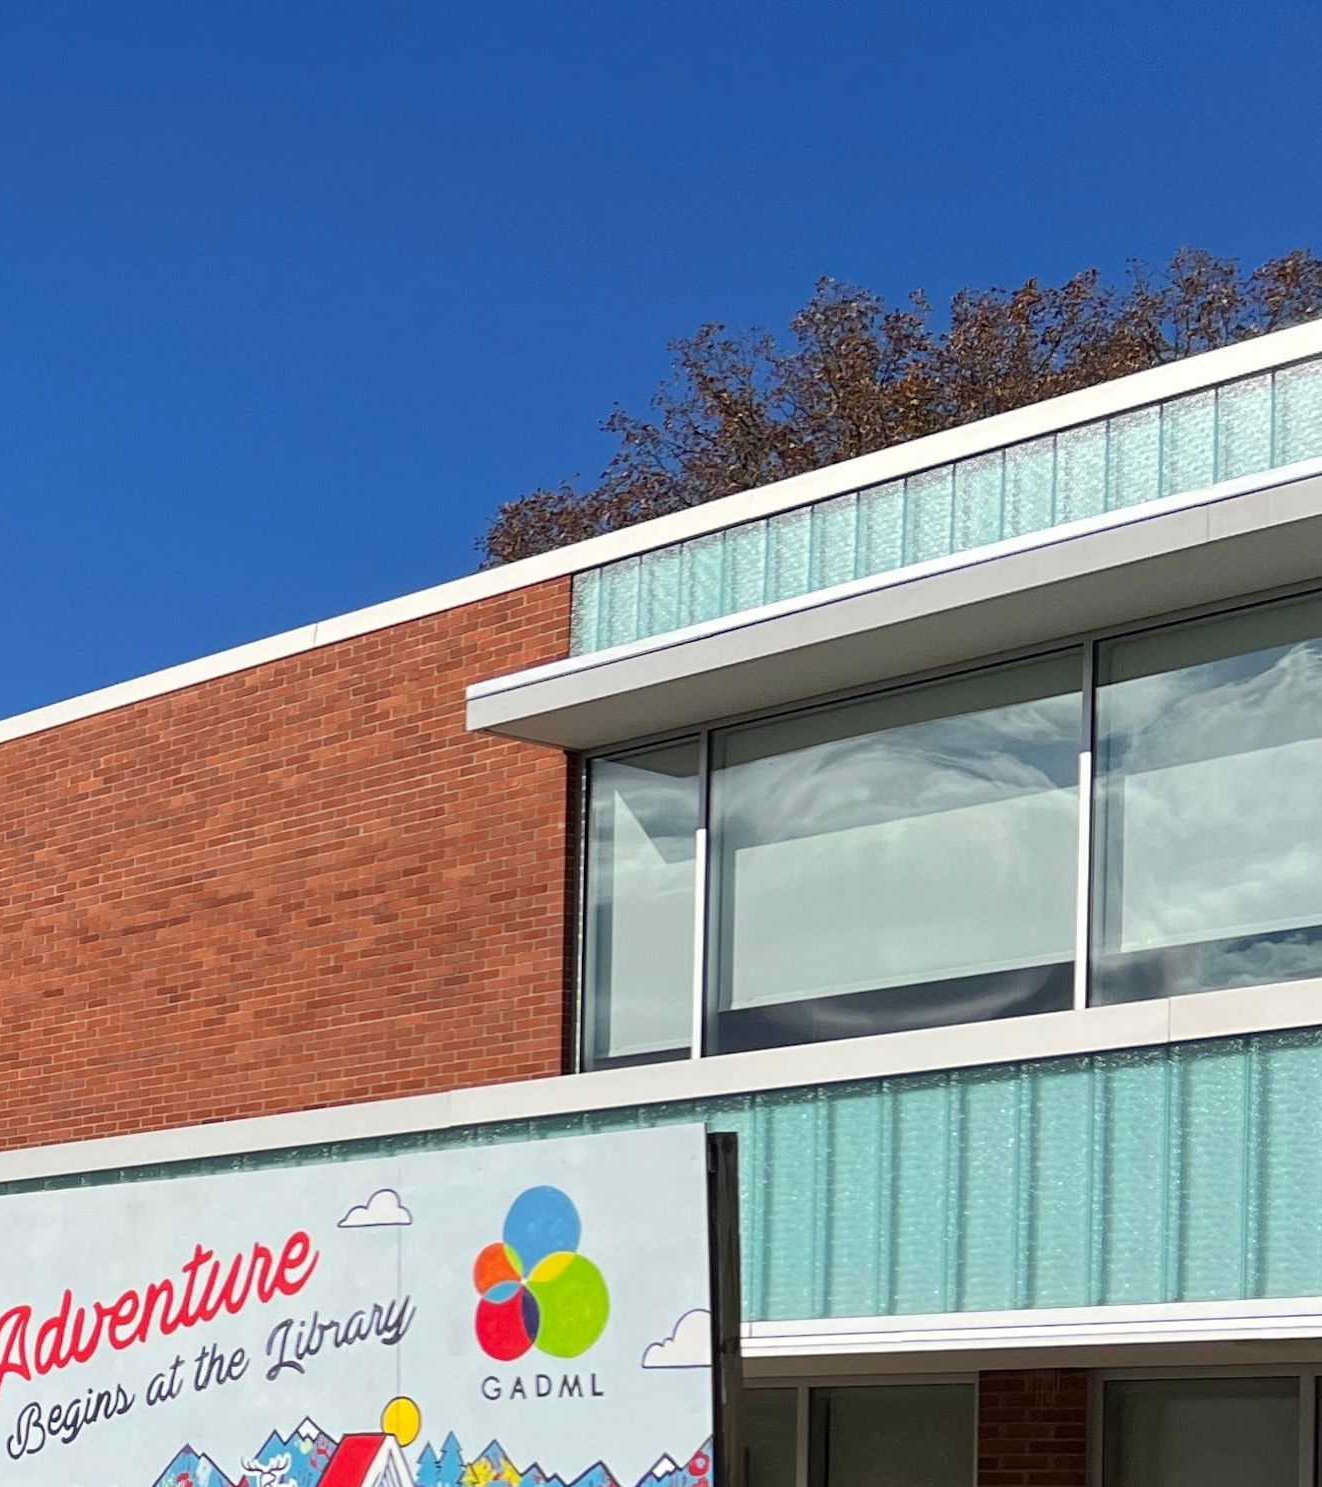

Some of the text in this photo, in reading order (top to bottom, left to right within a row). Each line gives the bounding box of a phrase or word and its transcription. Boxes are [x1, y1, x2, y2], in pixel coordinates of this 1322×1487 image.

[6, 1295, 417, 1460] Begins at the Library
[481, 1373, 604, 1400] GADML
